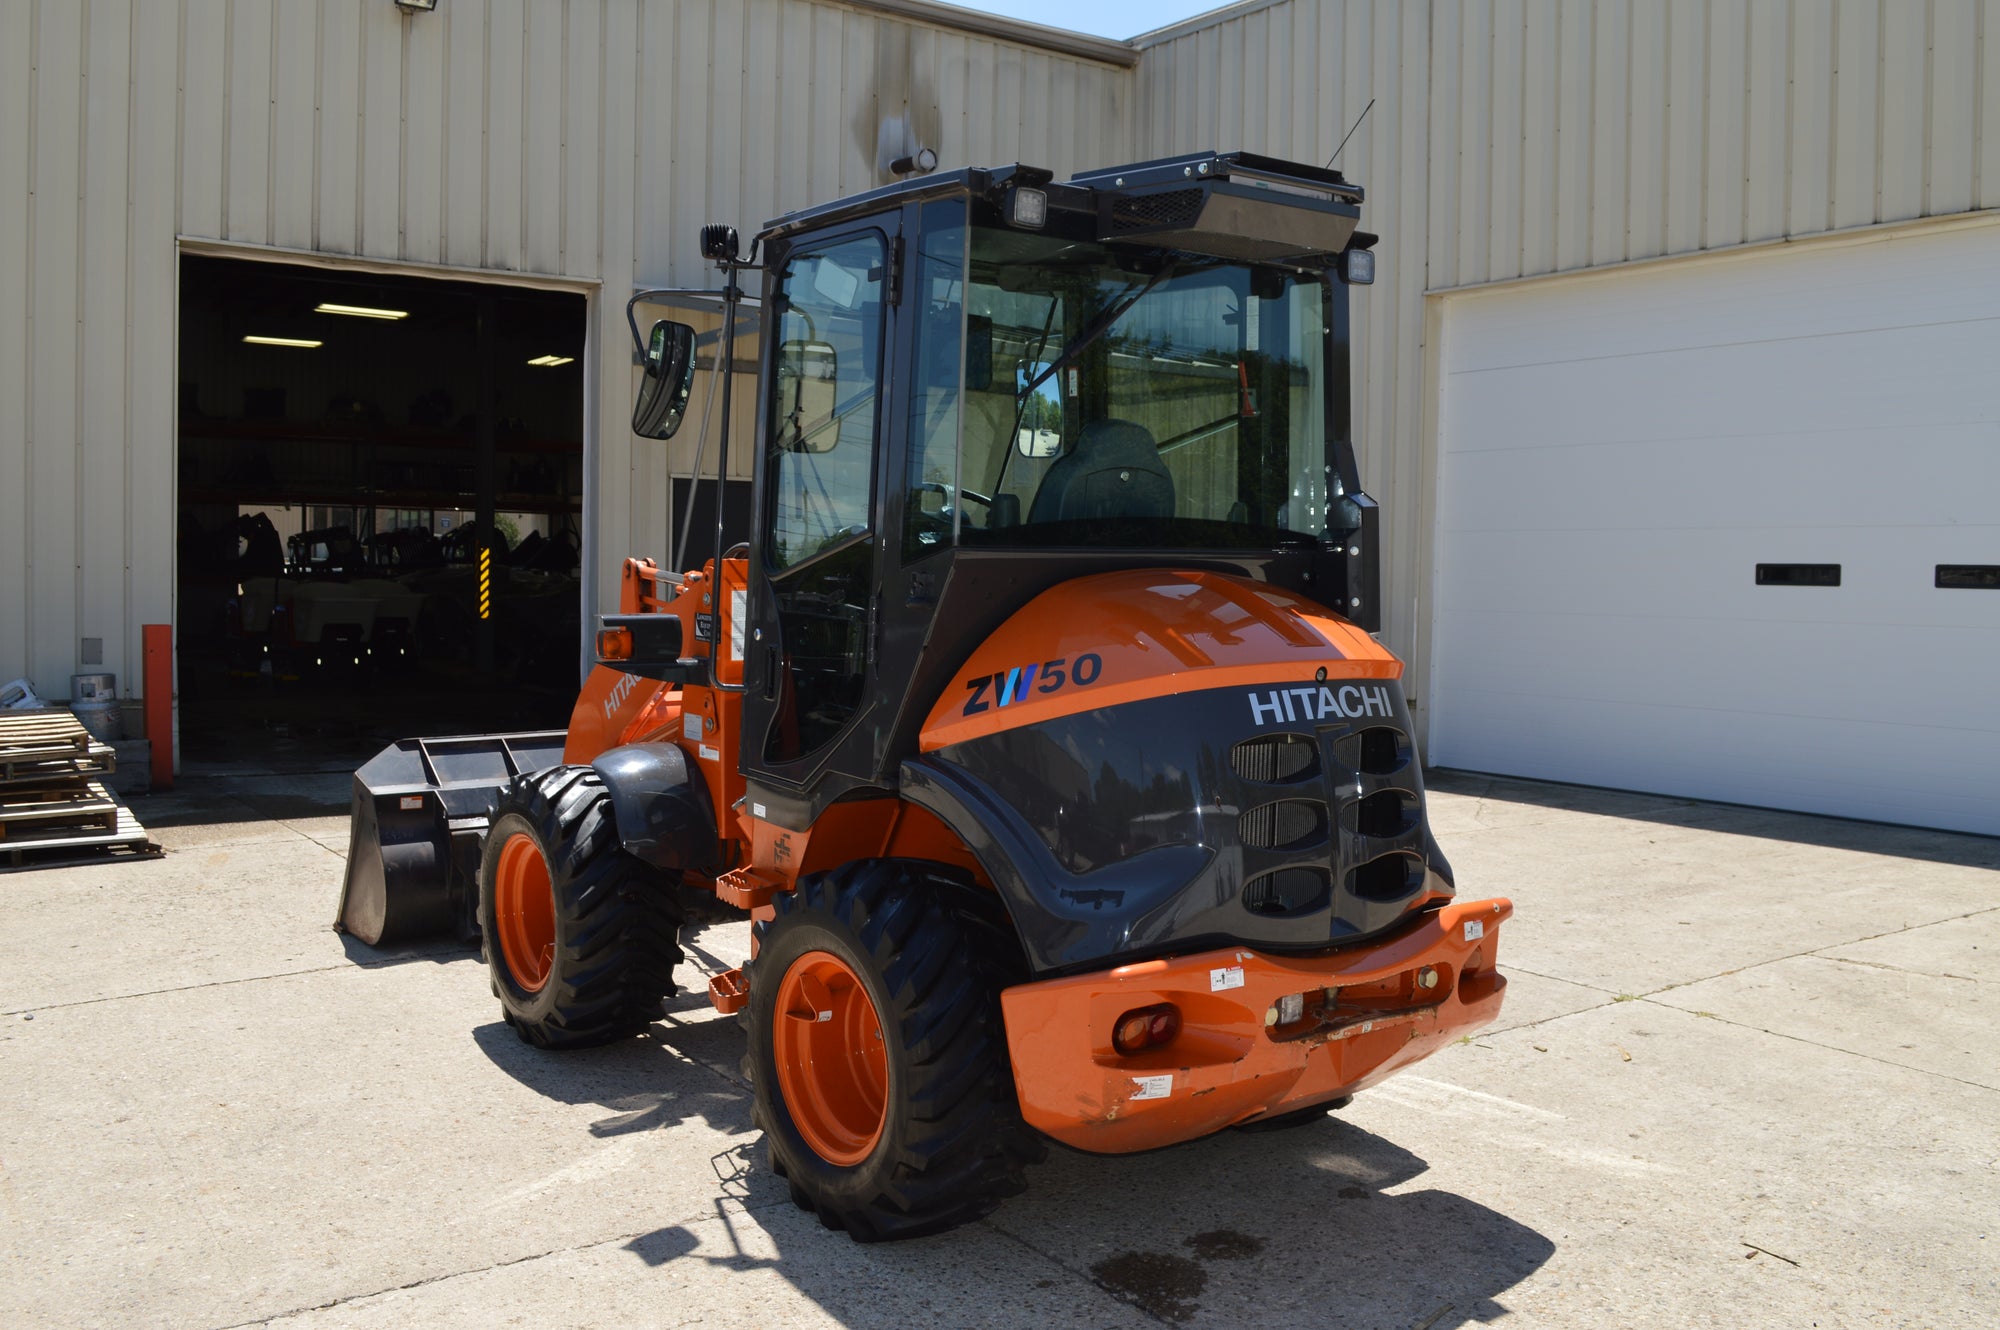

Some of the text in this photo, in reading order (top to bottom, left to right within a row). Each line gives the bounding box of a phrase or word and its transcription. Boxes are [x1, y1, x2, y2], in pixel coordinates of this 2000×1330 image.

[604, 673, 643, 720] HITA
[962, 653, 1103, 717] ZW50
[1248, 685, 1394, 726] HITACHI
